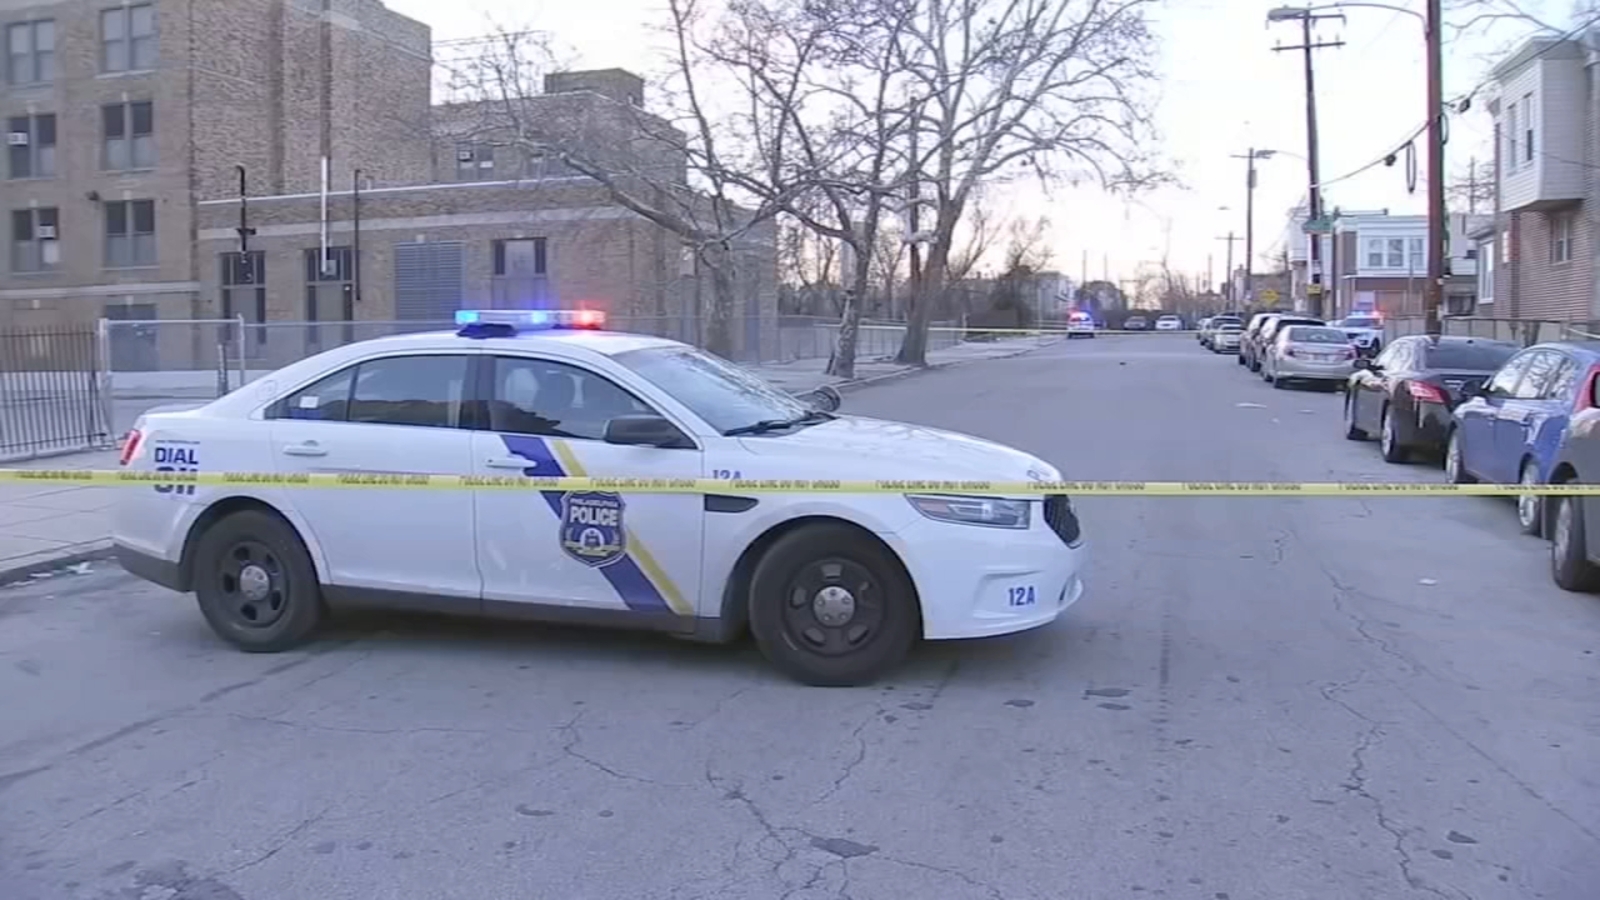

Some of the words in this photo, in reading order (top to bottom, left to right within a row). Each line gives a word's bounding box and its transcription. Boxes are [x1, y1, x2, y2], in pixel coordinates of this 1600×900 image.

[154, 447, 199, 465] DIAL
[570, 505, 618, 526] POLICE
[1009, 586, 1035, 606] 12A
